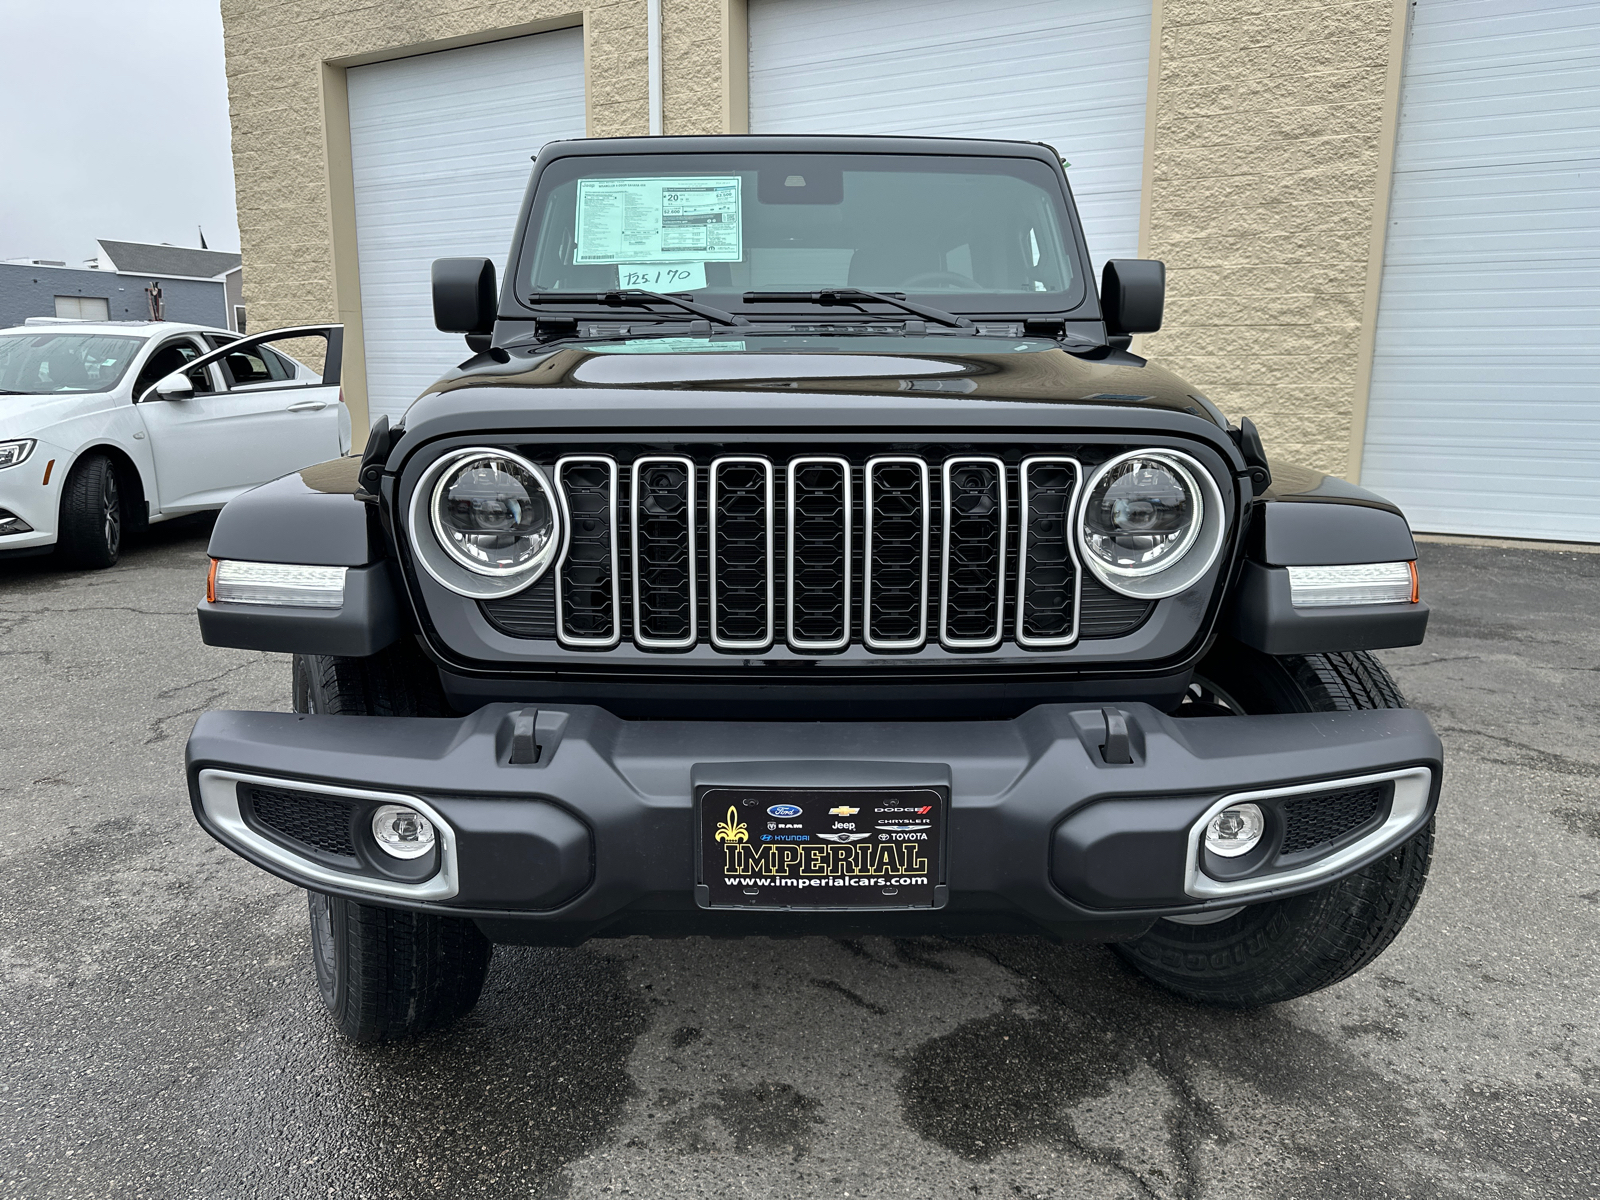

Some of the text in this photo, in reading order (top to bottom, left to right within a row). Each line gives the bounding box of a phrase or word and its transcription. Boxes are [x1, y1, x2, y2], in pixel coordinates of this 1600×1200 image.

[832, 821, 856, 831] Jeep
[724, 843, 928, 875] IMPERIAL
[724, 876, 928, 888] www.imperialcars.com
